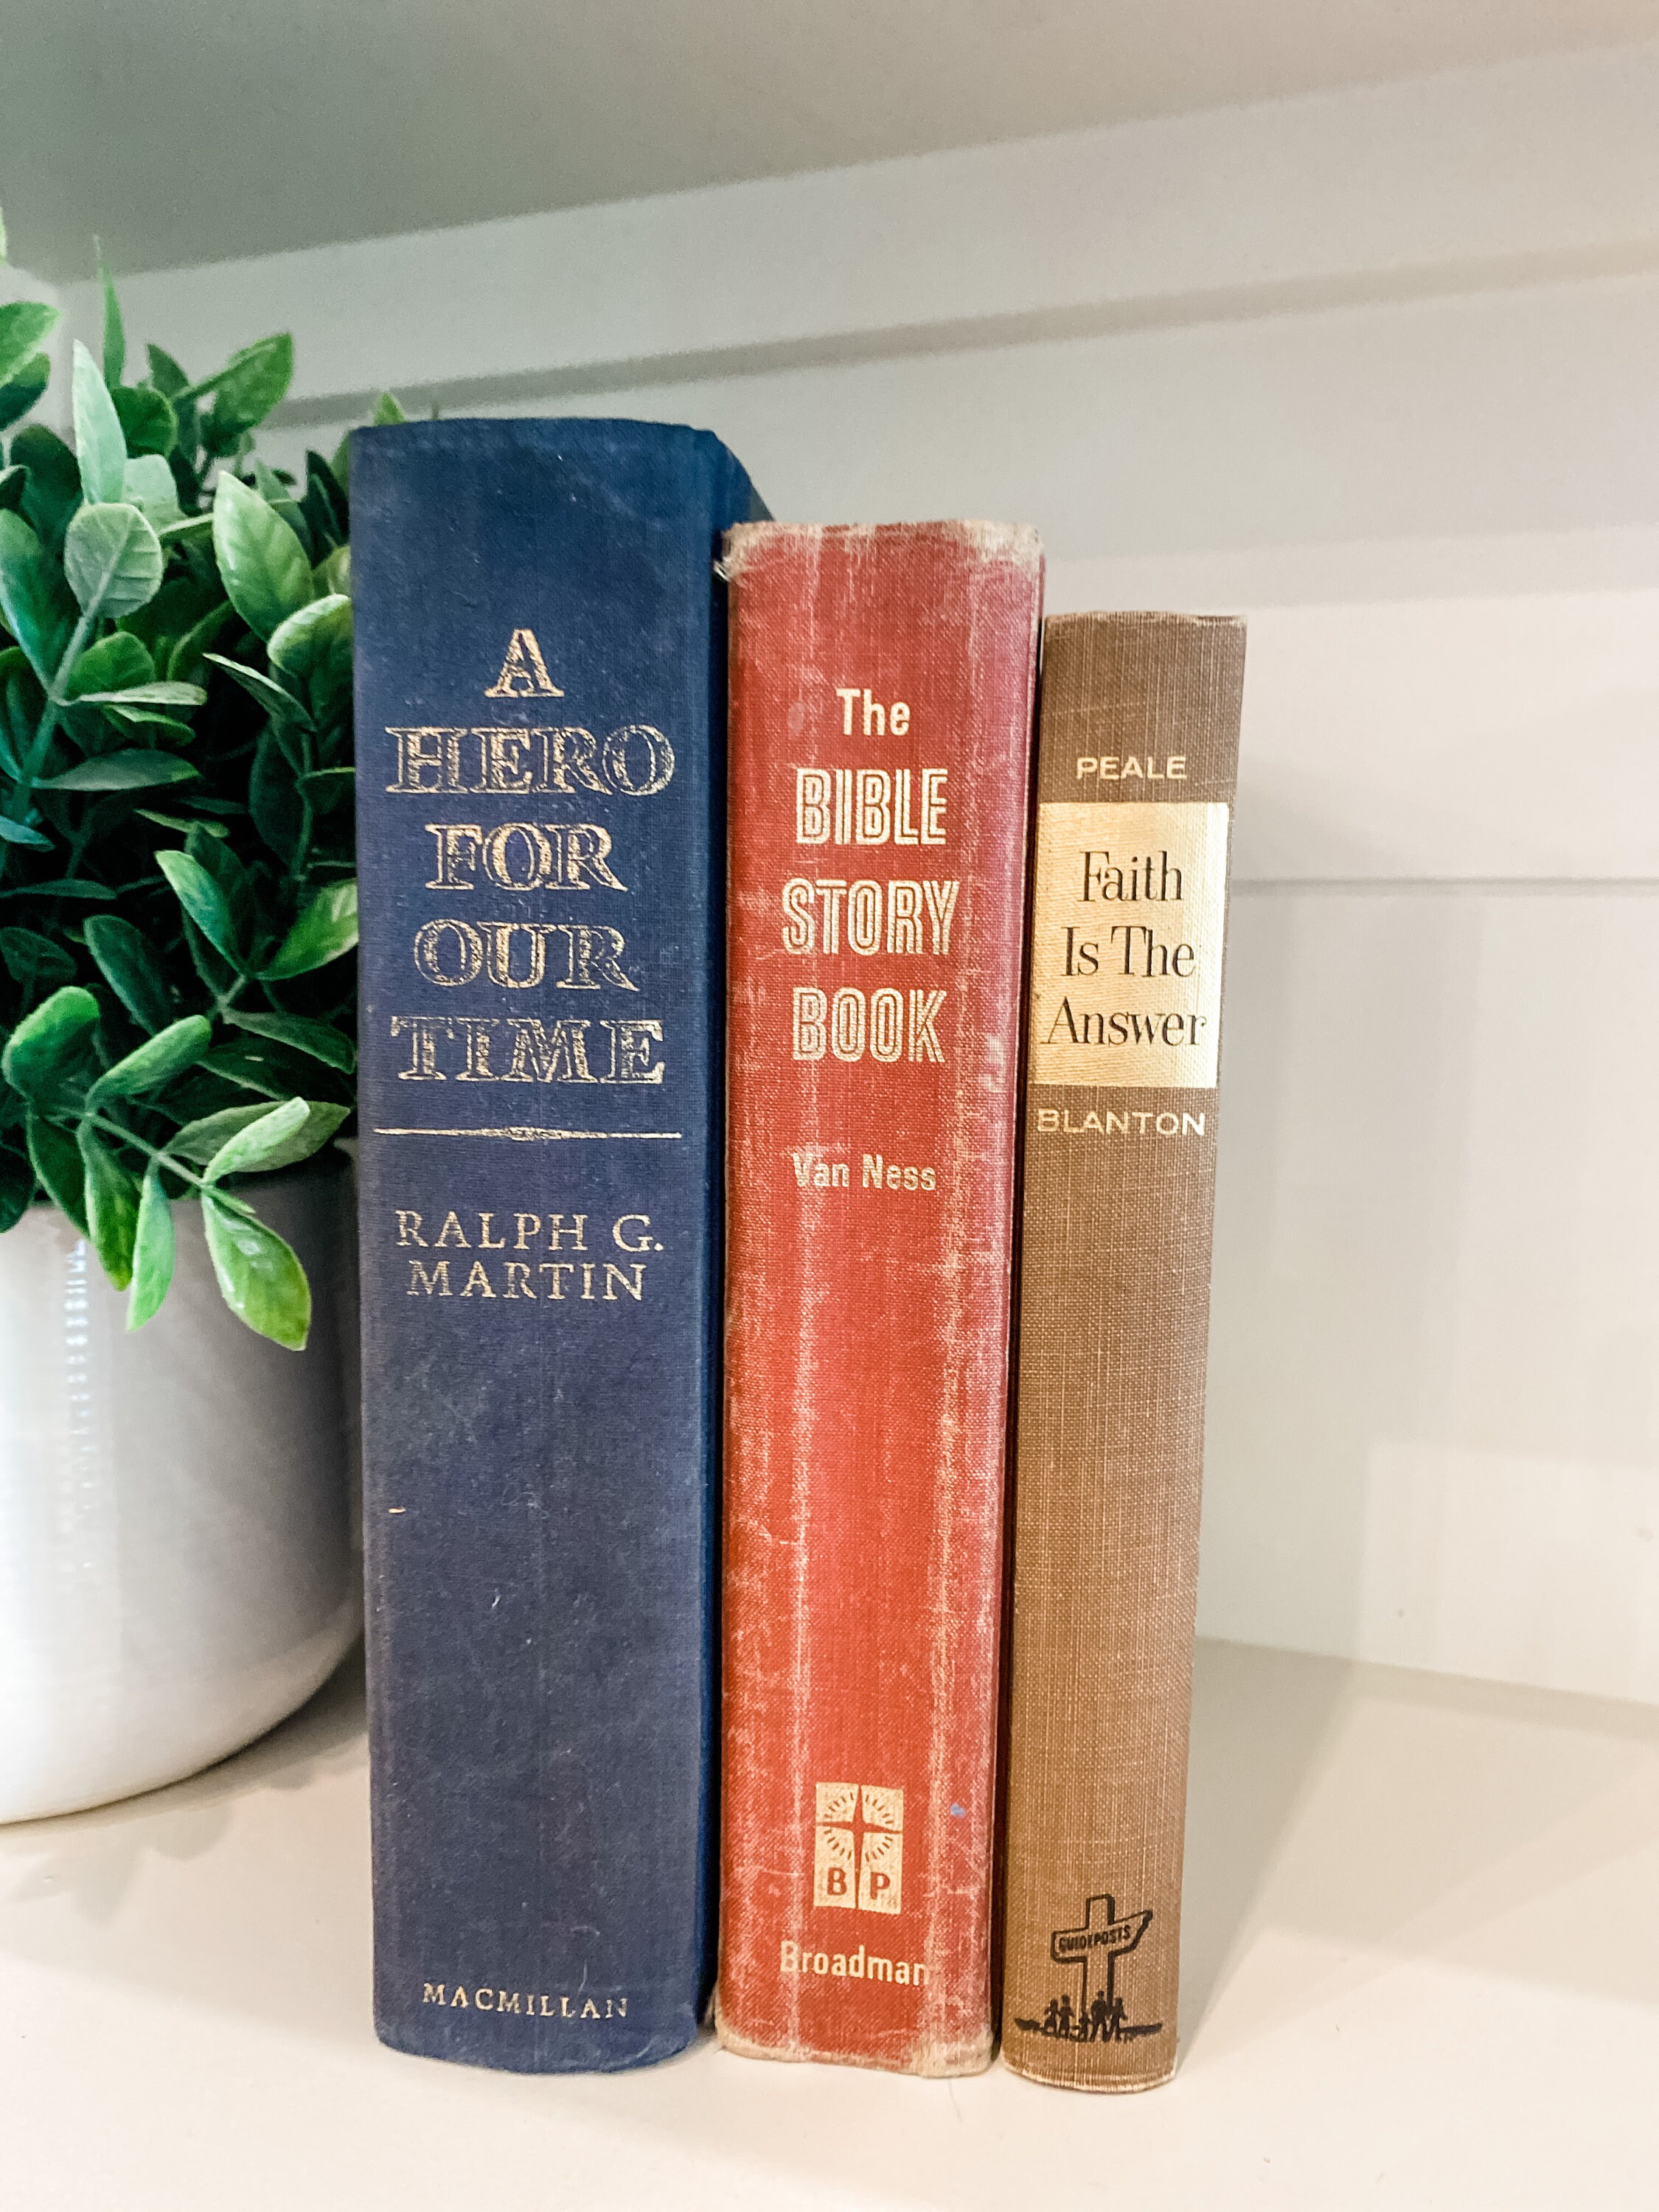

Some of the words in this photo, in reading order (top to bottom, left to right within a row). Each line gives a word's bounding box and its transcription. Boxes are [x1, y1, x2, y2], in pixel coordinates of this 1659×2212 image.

[484, 628, 565, 698] A
[835, 688, 911, 736] The
[385, 724, 676, 796] HERO
[1077, 756, 1187, 780] PEALE
[796, 768, 949, 846] BIBLE
[425, 822, 629, 892] FOR
[1077, 850, 1184, 902] Faith
[782, 877, 960, 956] STORY
[414, 918, 640, 992] OUR
[1060, 926, 1099, 977] Is
[1110, 925, 1195, 978] The
[792, 987, 947, 1063] BOOK
[1040, 995, 1208, 1047] Answer
[391, 1015, 665, 1085] TIME
[1037, 1108, 1206, 1136] BLANTON
[792, 1152, 850, 1189] Van
[862, 1153, 937, 1191] Ness
[395, 1209, 588, 1251] RALPH
[612, 1214, 664, 1253] G.
[406, 1259, 647, 1301] MARTIN
[827, 1867, 847, 1896] B
[869, 1871, 891, 1900] P
[779, 1940, 931, 1986] Broadman
[1058, 1924, 1132, 1952] GUIDEPOSTS
[422, 1982, 628, 2020] MACMILLAN
